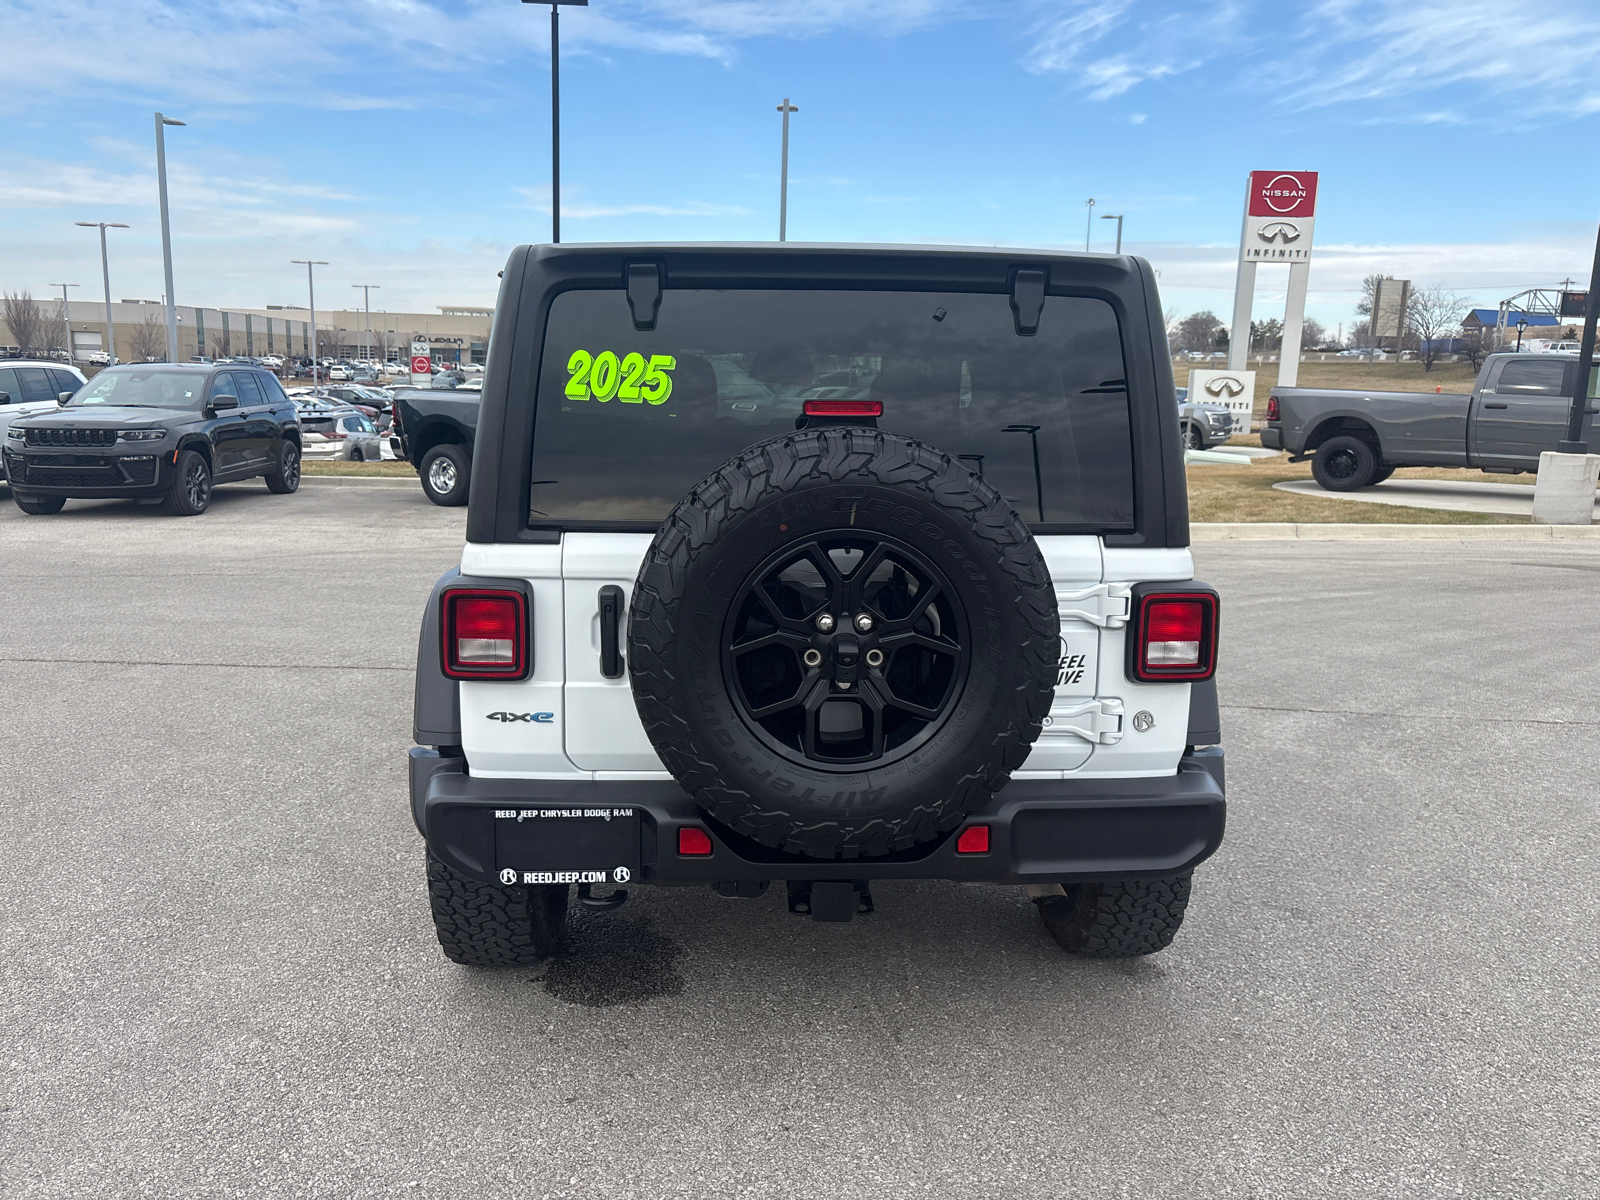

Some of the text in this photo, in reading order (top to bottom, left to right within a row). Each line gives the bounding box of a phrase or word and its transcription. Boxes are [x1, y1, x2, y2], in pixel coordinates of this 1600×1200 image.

[1262, 189, 1306, 197] NISSAN
[1247, 248, 1307, 258] INFINITI
[565, 350, 676, 405] 2025
[1059, 655, 1085, 669] EEL
[1057, 670, 1084, 685] IVE
[486, 711, 554, 723] 4xe
[495, 808, 633, 818] REED JEEP CHRYSLER DODGE RAM
[523, 871, 606, 884] REEDJEEP.COM
